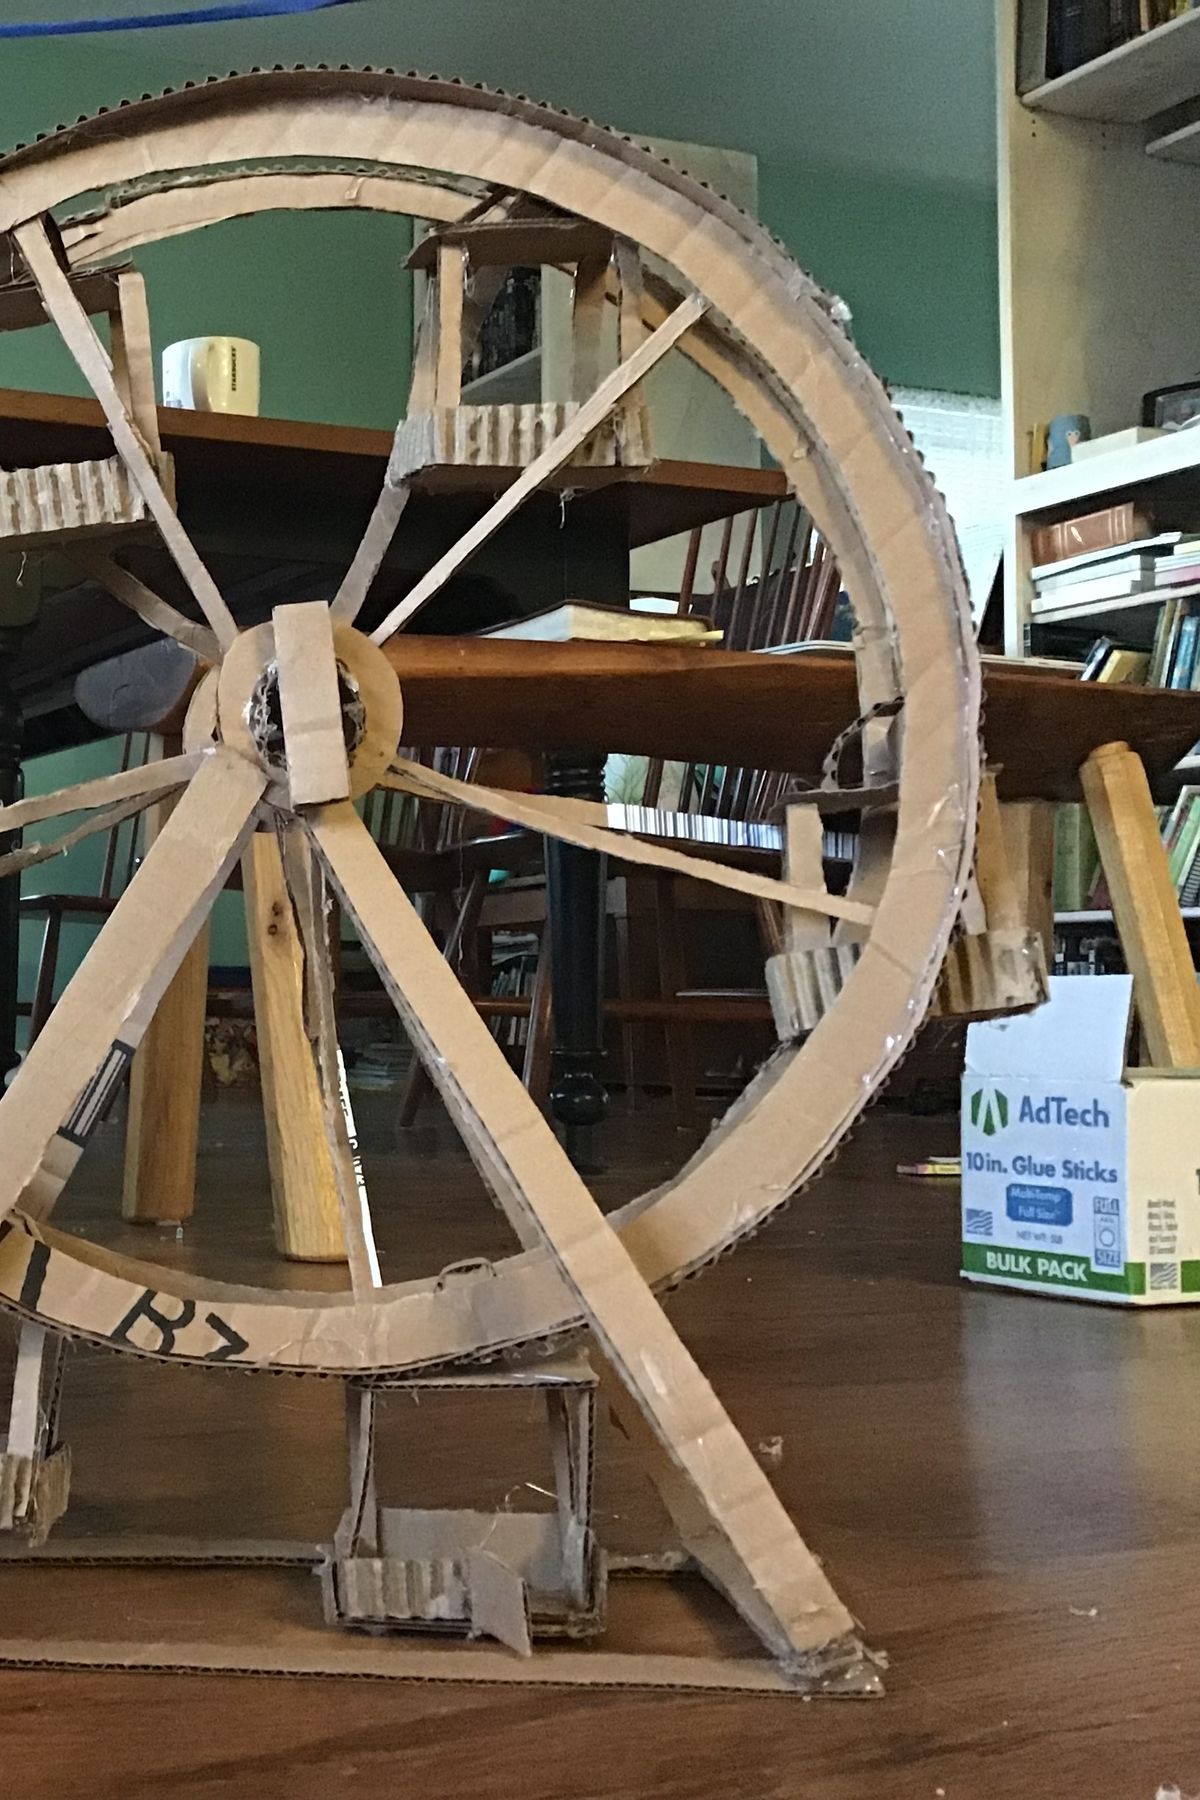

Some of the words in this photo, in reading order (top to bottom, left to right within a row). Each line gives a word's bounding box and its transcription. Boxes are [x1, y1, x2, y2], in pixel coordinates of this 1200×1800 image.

[1019, 1095, 1110, 1128] AdTech
[1012, 1155, 1056, 1178] Glue
[1062, 1159, 1118, 1183] Sticks
[986, 1251, 1032, 1274] BULK
[1037, 1258, 1088, 1281] PACK
[1096, 1250, 1120, 1267] SIZE
